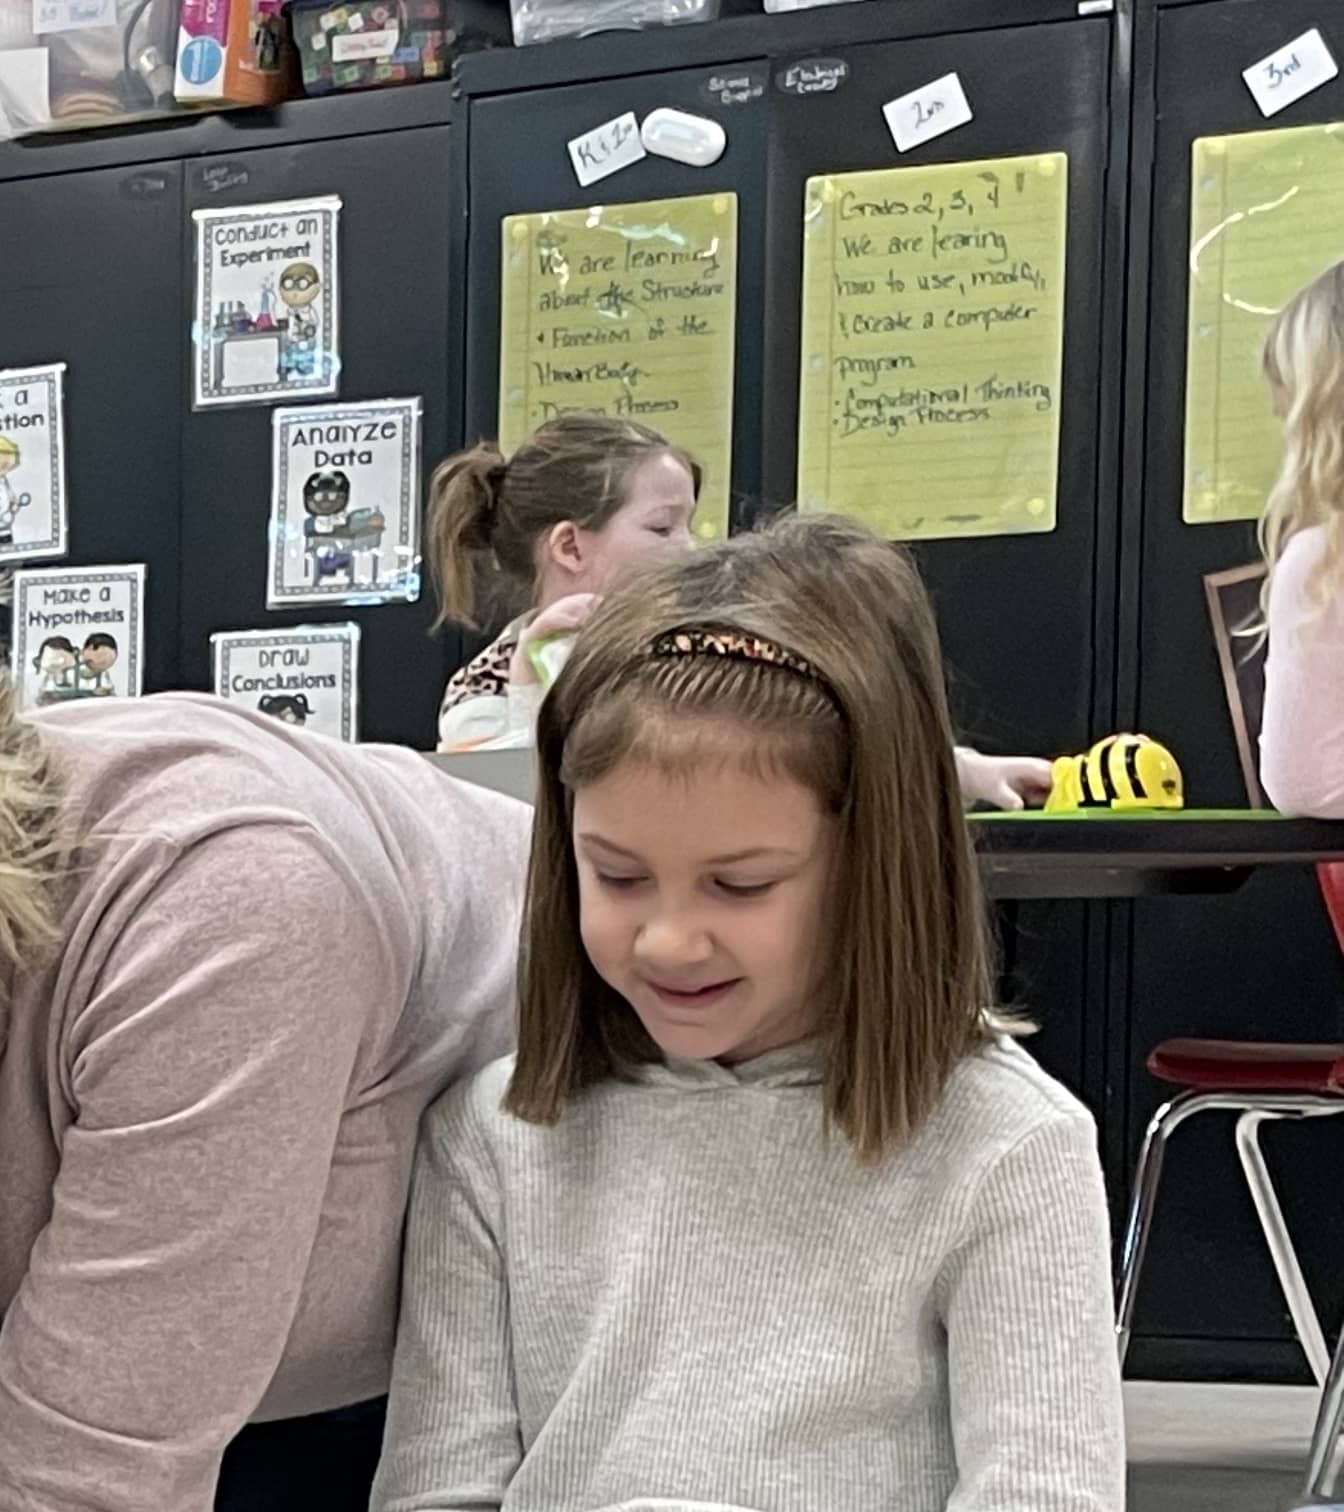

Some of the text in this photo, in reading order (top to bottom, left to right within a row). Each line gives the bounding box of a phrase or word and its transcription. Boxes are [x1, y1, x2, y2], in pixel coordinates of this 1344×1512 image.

[1263, 52, 1301, 89] 3rd
[215, 218, 318, 246] Conduct an
[220, 241, 310, 268] Experiment
[843, 235, 872, 258] We
[888, 235, 924, 255] are
[579, 254, 616, 275] are
[887, 269, 906, 293] to
[923, 312, 934, 329] a
[14, 389, 28, 406] a
[314, 448, 373, 468] Data
[99, 586, 111, 602] a
[29, 608, 125, 629] Hypothesis
[258, 648, 310, 668] Draw
[232, 672, 337, 693] Conclusions
